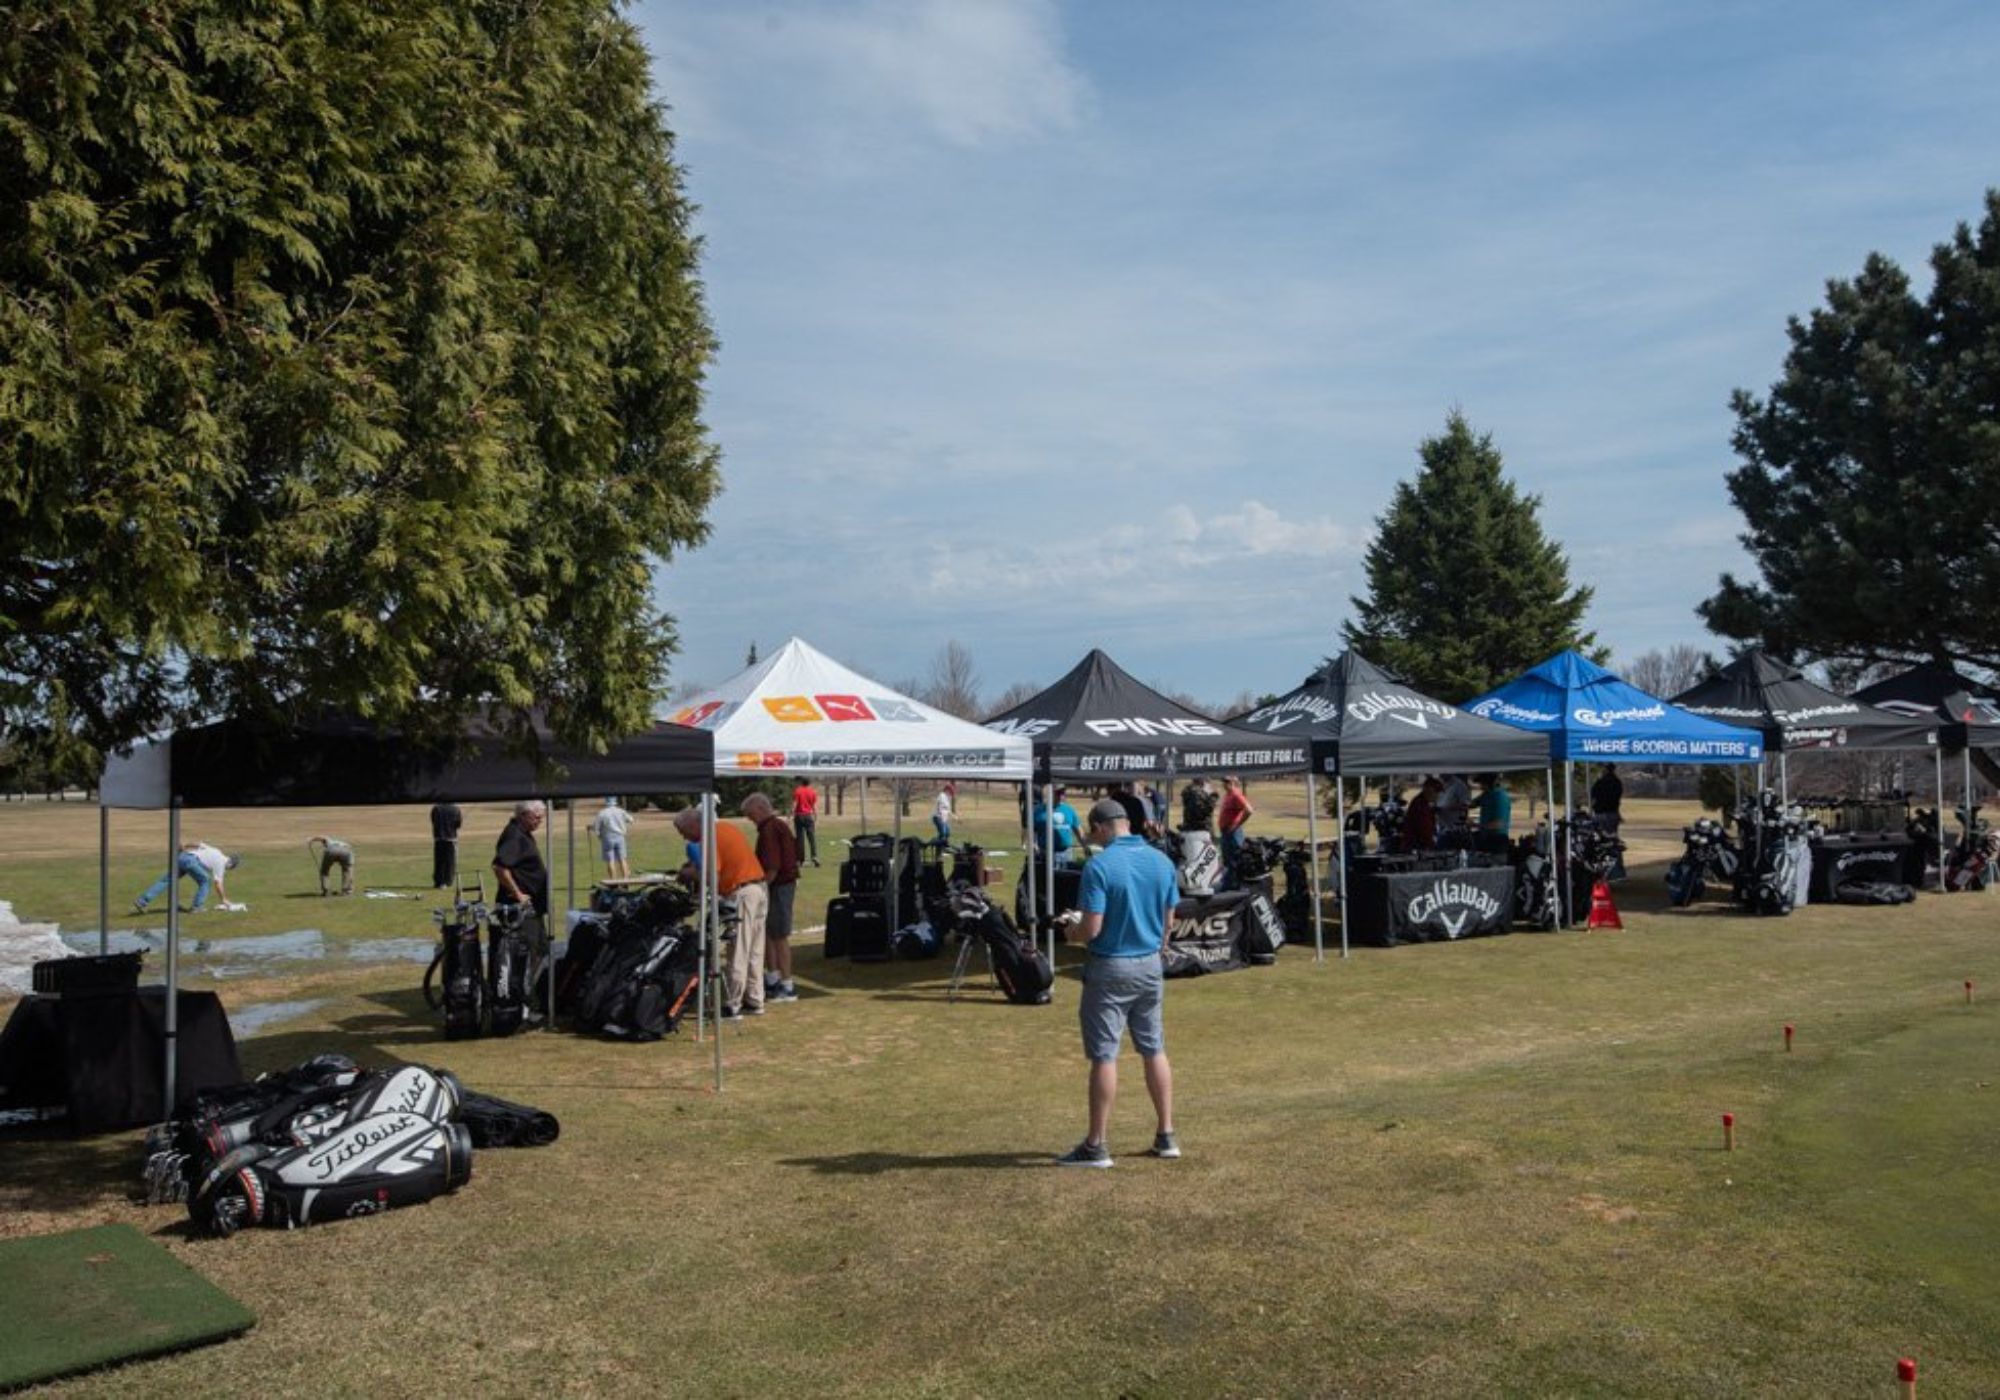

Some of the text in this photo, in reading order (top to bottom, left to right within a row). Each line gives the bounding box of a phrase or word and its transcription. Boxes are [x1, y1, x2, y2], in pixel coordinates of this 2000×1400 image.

[1347, 691, 1457, 721] Callaway
[1084, 718, 1223, 737] PING
[1582, 739, 1746, 755] WHERE SCORING MATTERS
[818, 752, 1001, 766] COBRA PUMA GOLF
[1080, 755, 1156, 771] GET FIT TODAY
[1184, 752, 1218, 767] YOU'LL
[1221, 751, 1234, 766] BE
[1236, 750, 1272, 765] BETTER
[1273, 749, 1292, 764] FOR
[1408, 878, 1500, 924] Callaway
[1251, 896, 1286, 949] PING
[308, 1114, 416, 1179] Titleist
